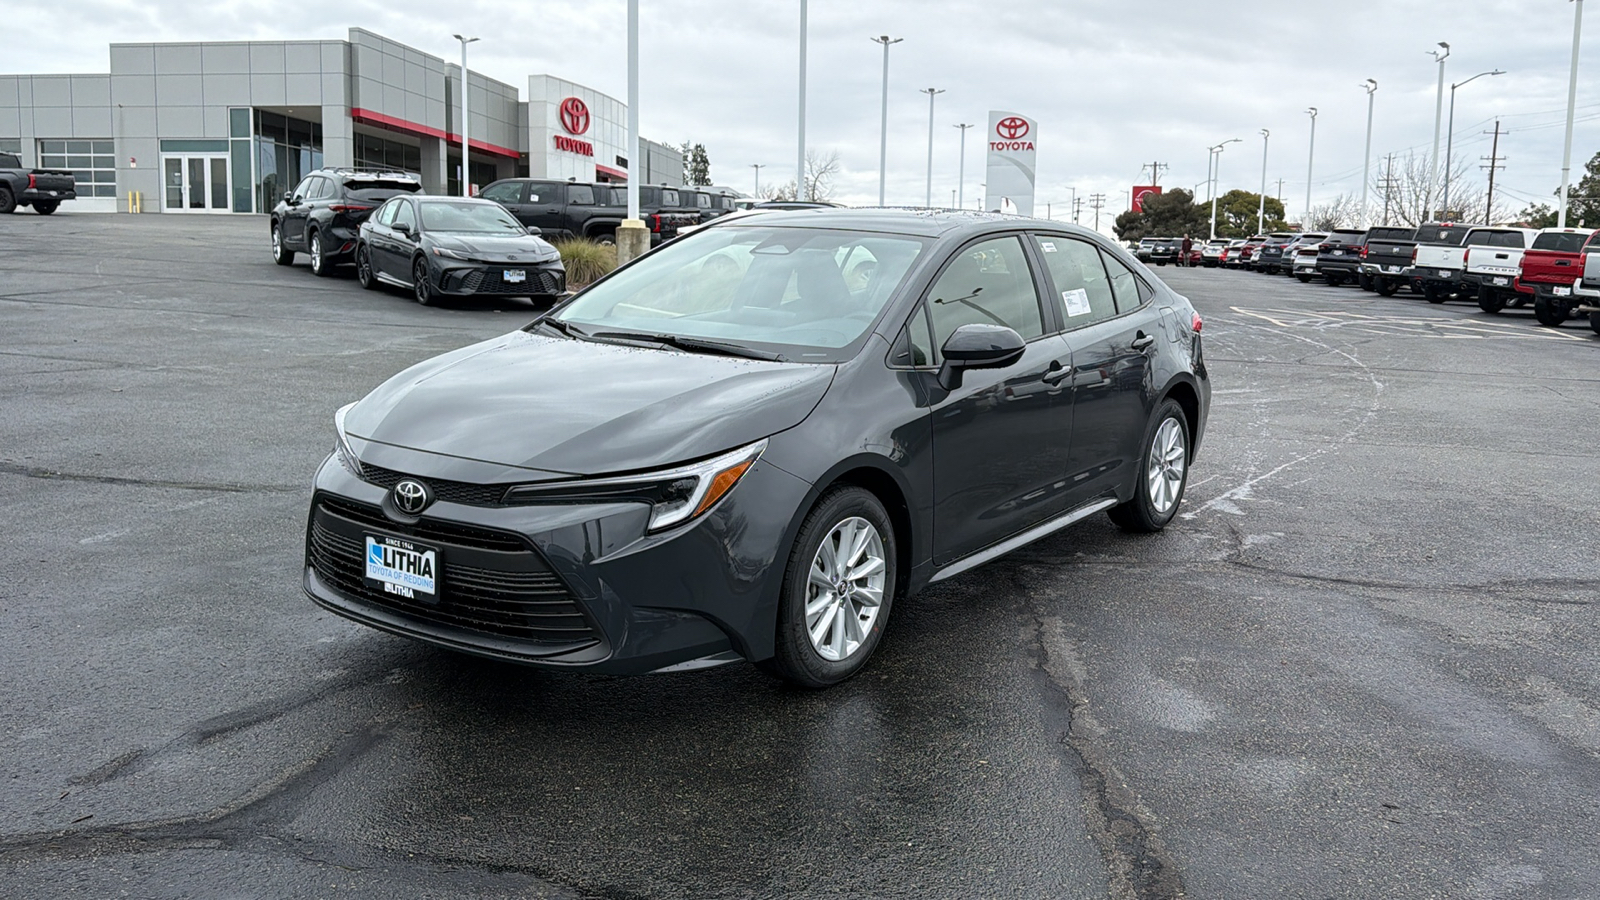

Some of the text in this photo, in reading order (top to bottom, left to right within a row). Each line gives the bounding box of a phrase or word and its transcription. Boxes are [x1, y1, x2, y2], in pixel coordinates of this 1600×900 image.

[553, 134, 594, 157] TOYOTA
[989, 141, 1035, 151] TOYOTA
[385, 537, 414, 550] SINCE 1946
[383, 547, 433, 579] LITHIA
[368, 564, 434, 589] TOYOTA OF REDDING
[391, 583, 414, 599] LITHIA
